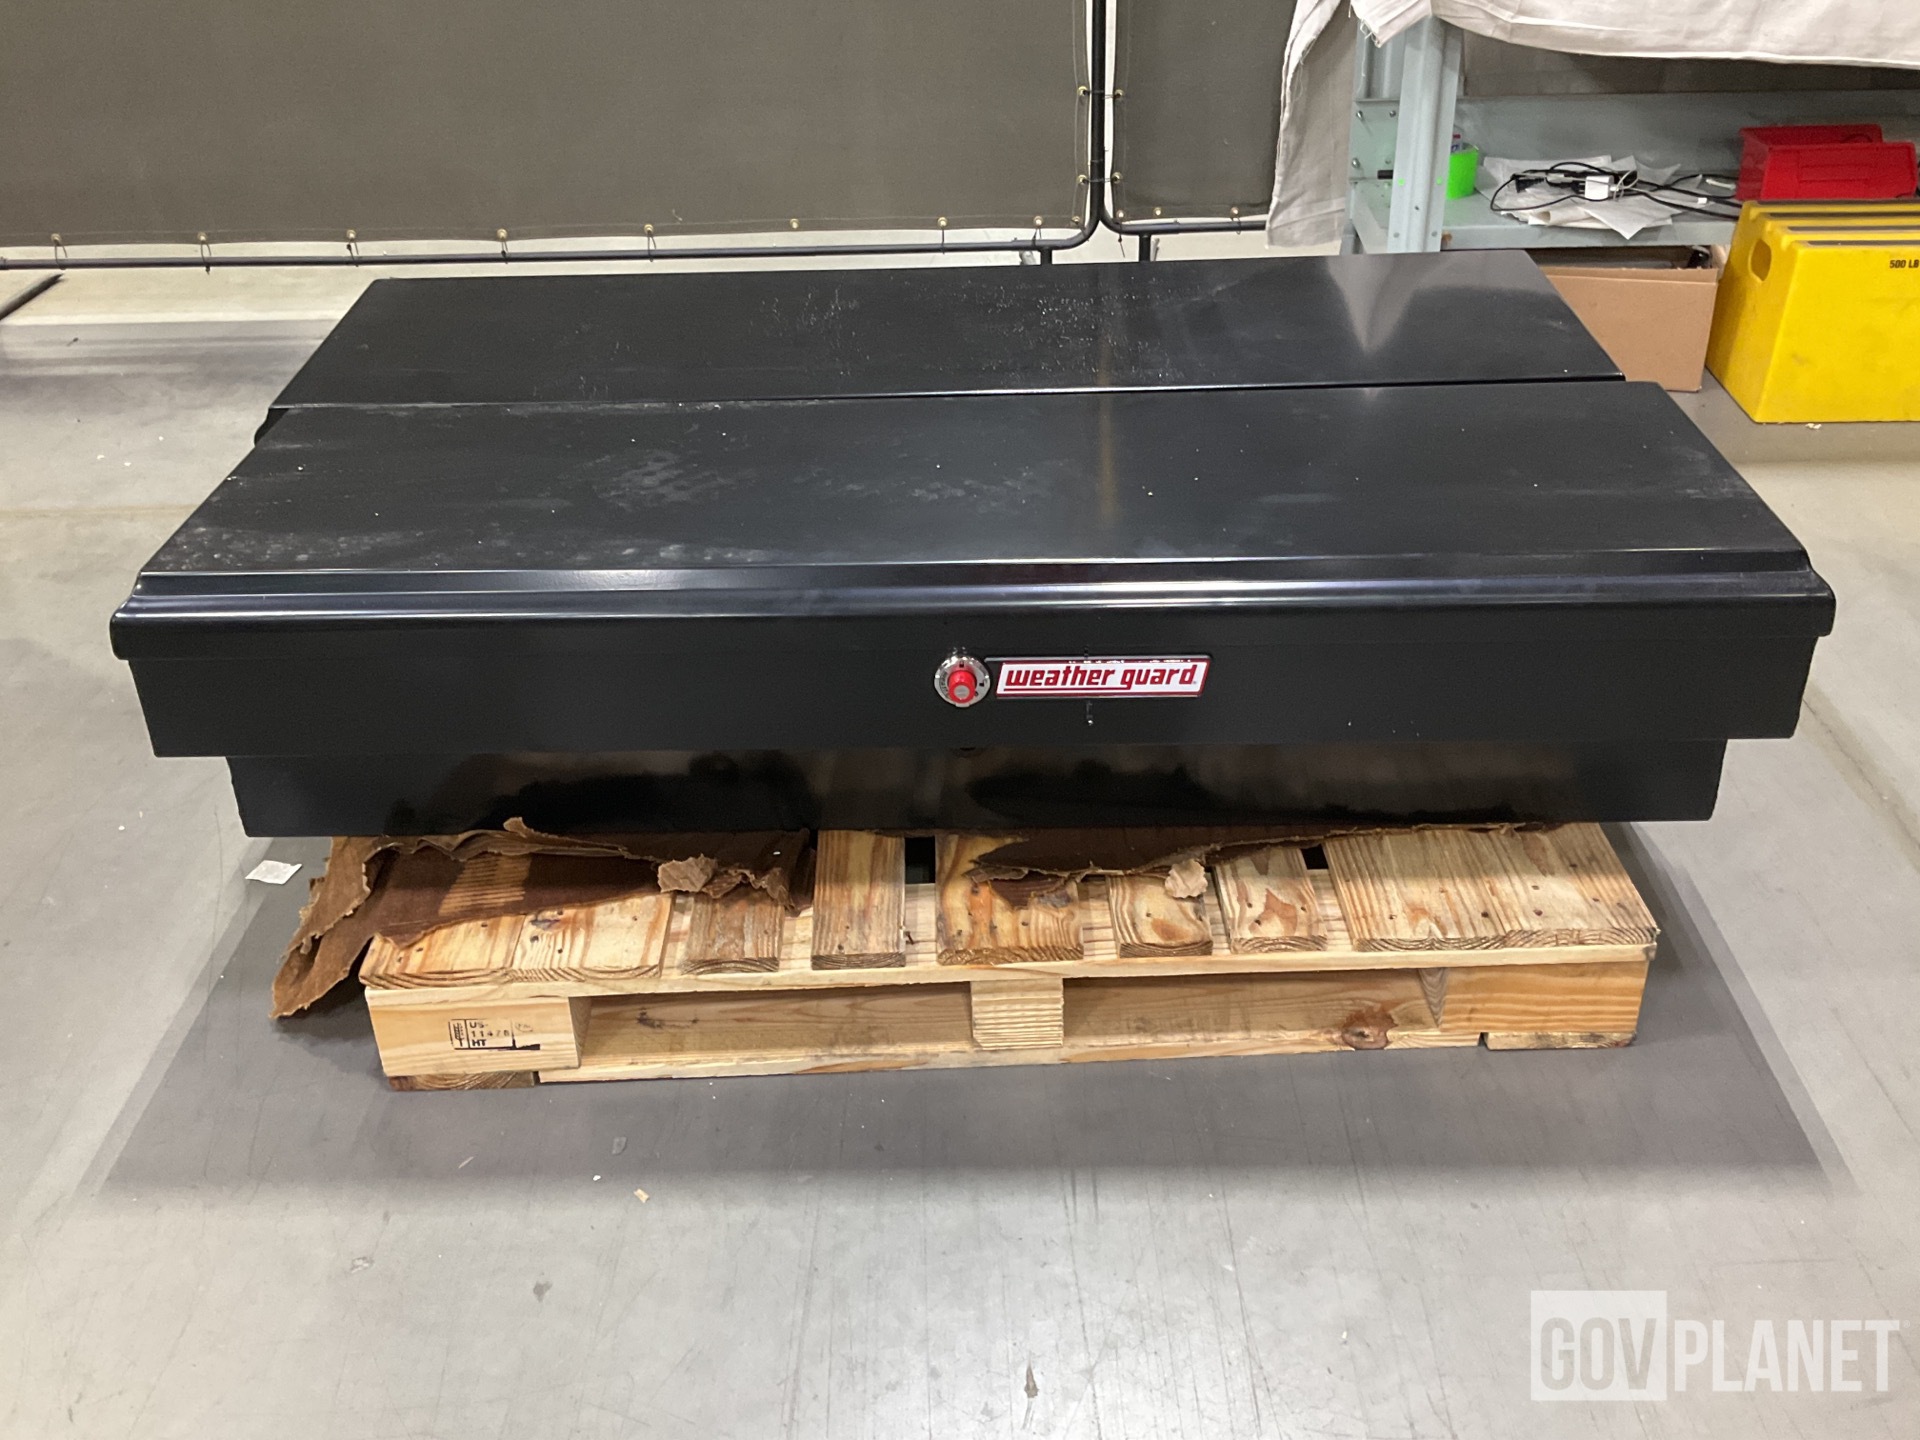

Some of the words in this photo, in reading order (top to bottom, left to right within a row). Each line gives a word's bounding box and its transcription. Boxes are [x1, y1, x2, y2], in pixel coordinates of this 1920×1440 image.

[1890, 259, 1906, 269] 500
[1908, 259, 1919, 269] LB
[1005, 666, 1115, 687] weather
[1120, 665, 1197, 690] guard
[472, 1039, 487, 1047] HT
